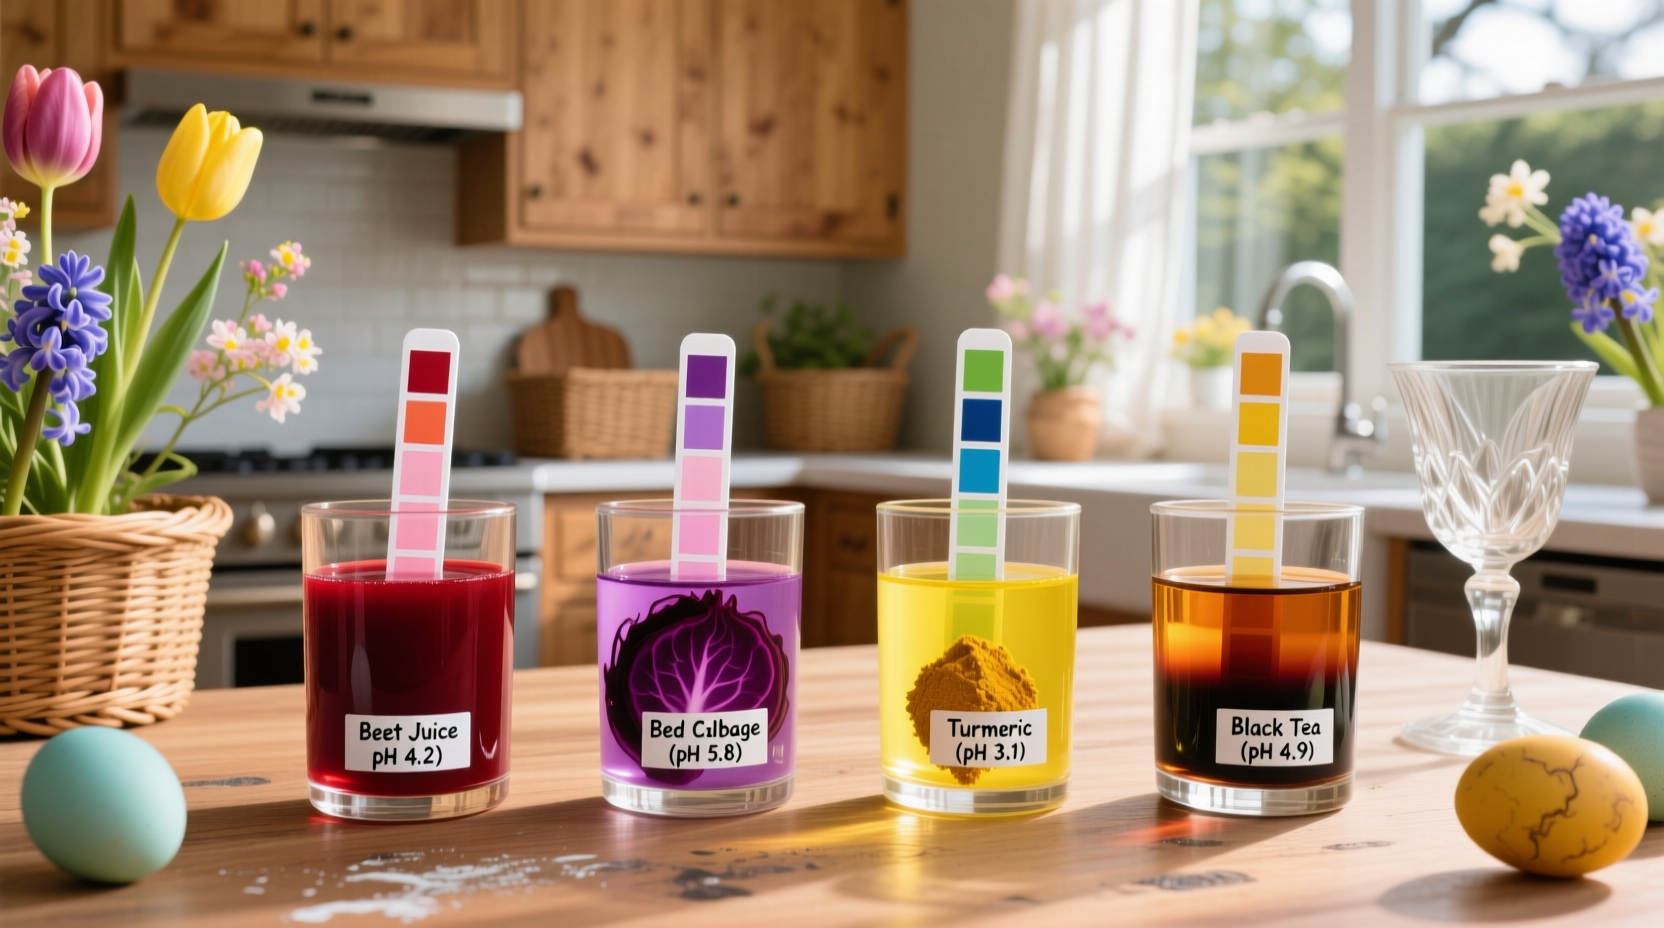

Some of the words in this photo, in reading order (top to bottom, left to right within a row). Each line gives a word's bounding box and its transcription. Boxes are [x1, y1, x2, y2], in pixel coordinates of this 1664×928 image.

[359, 721, 403, 741] Beet
[407, 722, 458, 741] Juice
[650, 719, 685, 738] Bed
[947, 718, 1032, 737] Turmeric
[1231, 716, 1284, 736] Black
[1289, 718, 1321, 736] Tea
[371, 747, 398, 771] pH
[404, 745, 443, 766] 4.2)
[668, 744, 700, 768] (pH
[707, 742, 742, 763] 5.8)
[955, 742, 987, 765] (pH
[994, 742, 1026, 761] 3.1)
[1240, 741, 1273, 765] (pH
[1279, 741, 1314, 761] 4.9)
